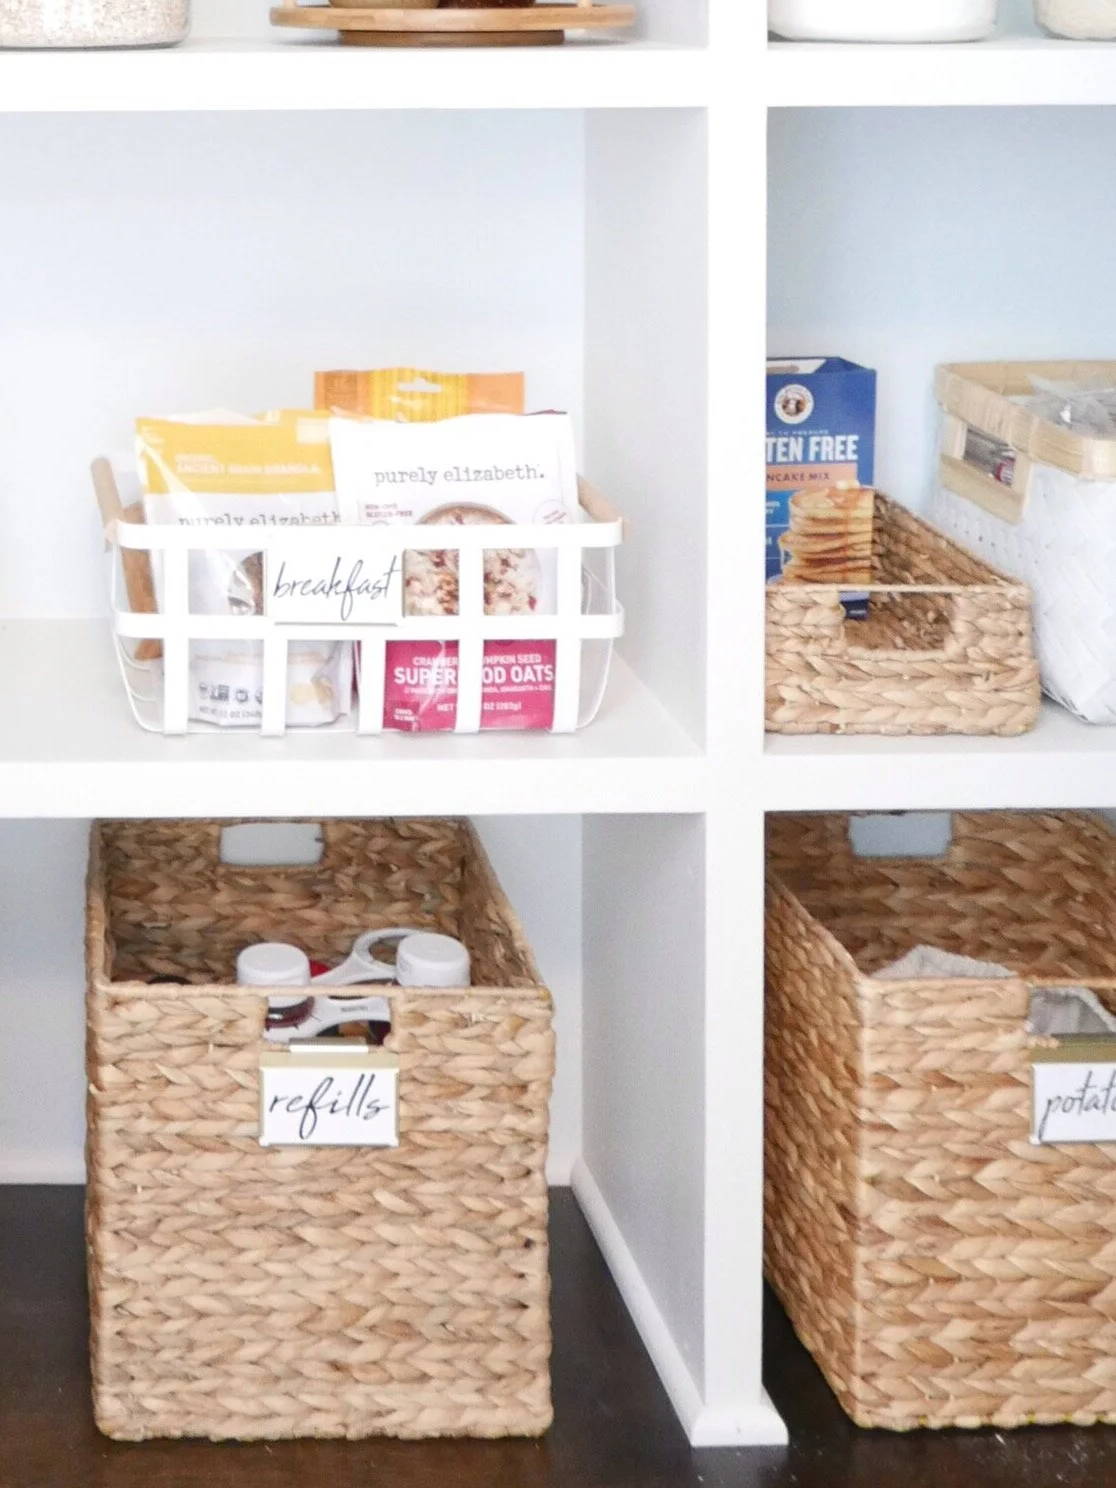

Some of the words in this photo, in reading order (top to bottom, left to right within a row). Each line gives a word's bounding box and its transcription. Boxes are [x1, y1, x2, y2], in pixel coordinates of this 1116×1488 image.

[765, 436, 803, 463] TEN
[808, 434, 859, 462] FREE
[374, 466, 438, 487] purely
[766, 473, 805, 483] NCAKE
[808, 472, 830, 481] MIX
[272, 554, 402, 621] breakfast
[412, 656, 460, 667] CRANBER
[483, 654, 516, 665] MPKIN
[517, 653, 542, 664] SEED
[393, 664, 507, 685] SUPEROD
[509, 664, 555, 683] OATS
[269, 1073, 391, 1140] refills
